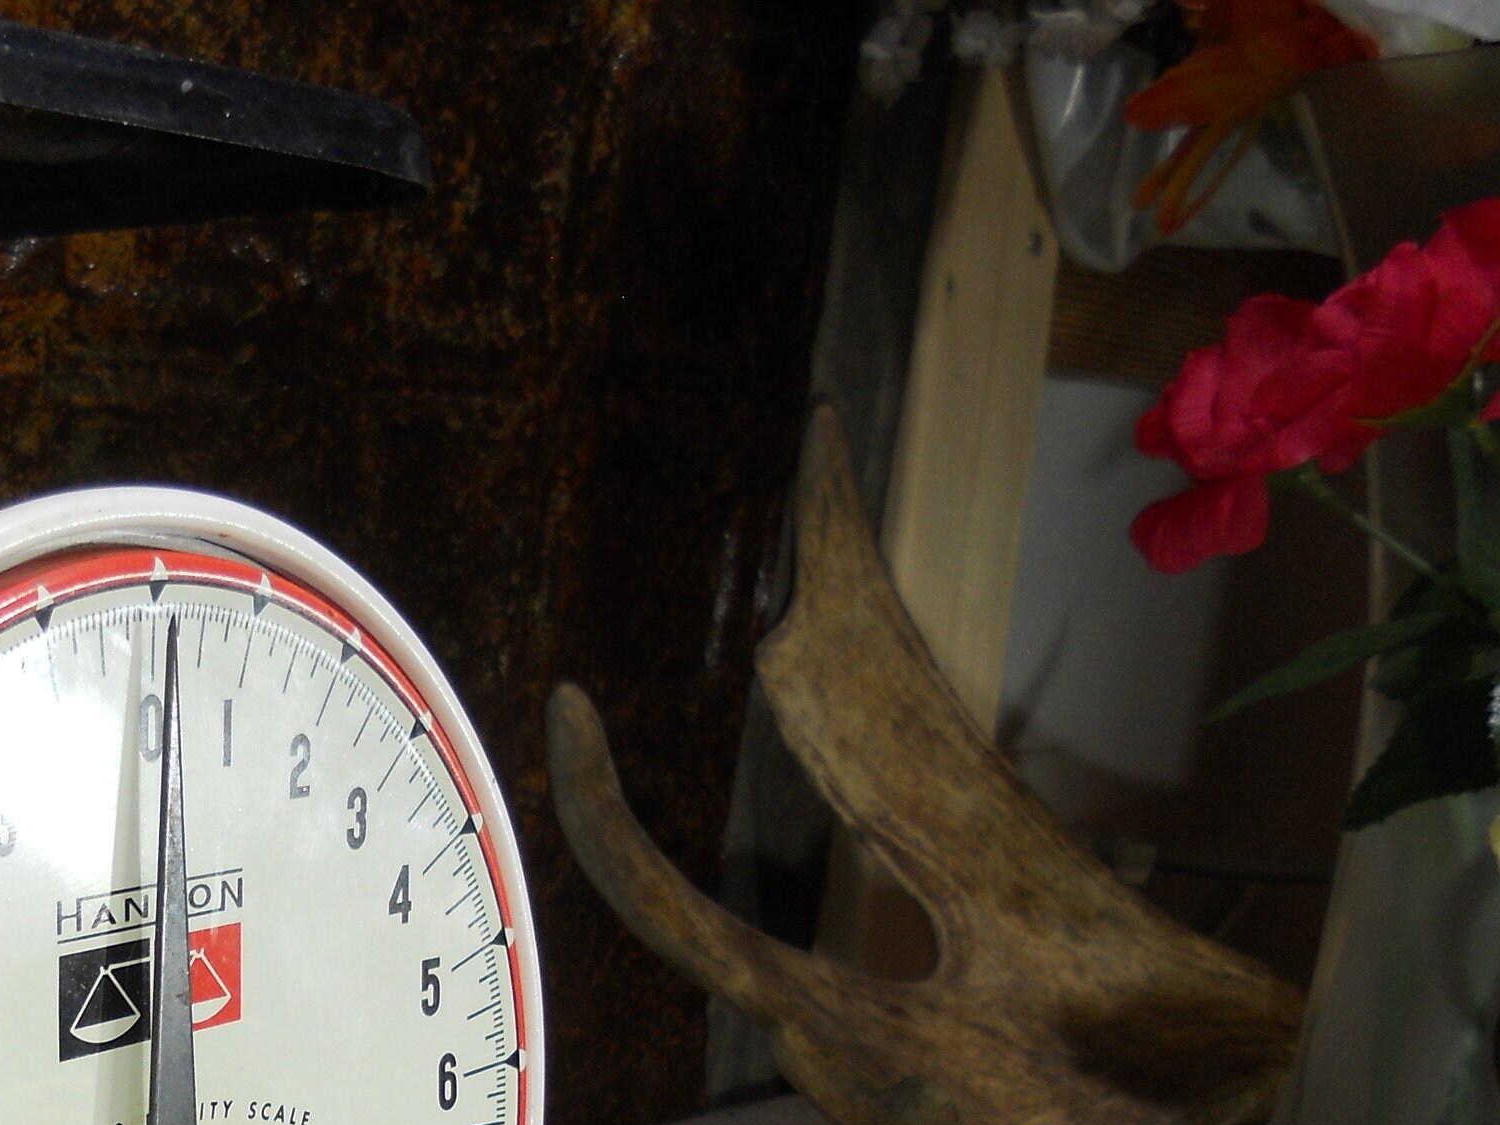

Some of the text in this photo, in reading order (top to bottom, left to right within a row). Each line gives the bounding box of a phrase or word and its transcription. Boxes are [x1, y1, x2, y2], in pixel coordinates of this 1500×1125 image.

[140, 694, 163, 763] 0
[223, 698, 233, 767] 1
[289, 733, 311, 799] 2
[346, 787, 367, 849] 3
[56, 877, 243, 935] HANON
[388, 864, 412, 924] 4
[421, 957, 440, 1016] 5
[438, 1053, 457, 1110] 6
